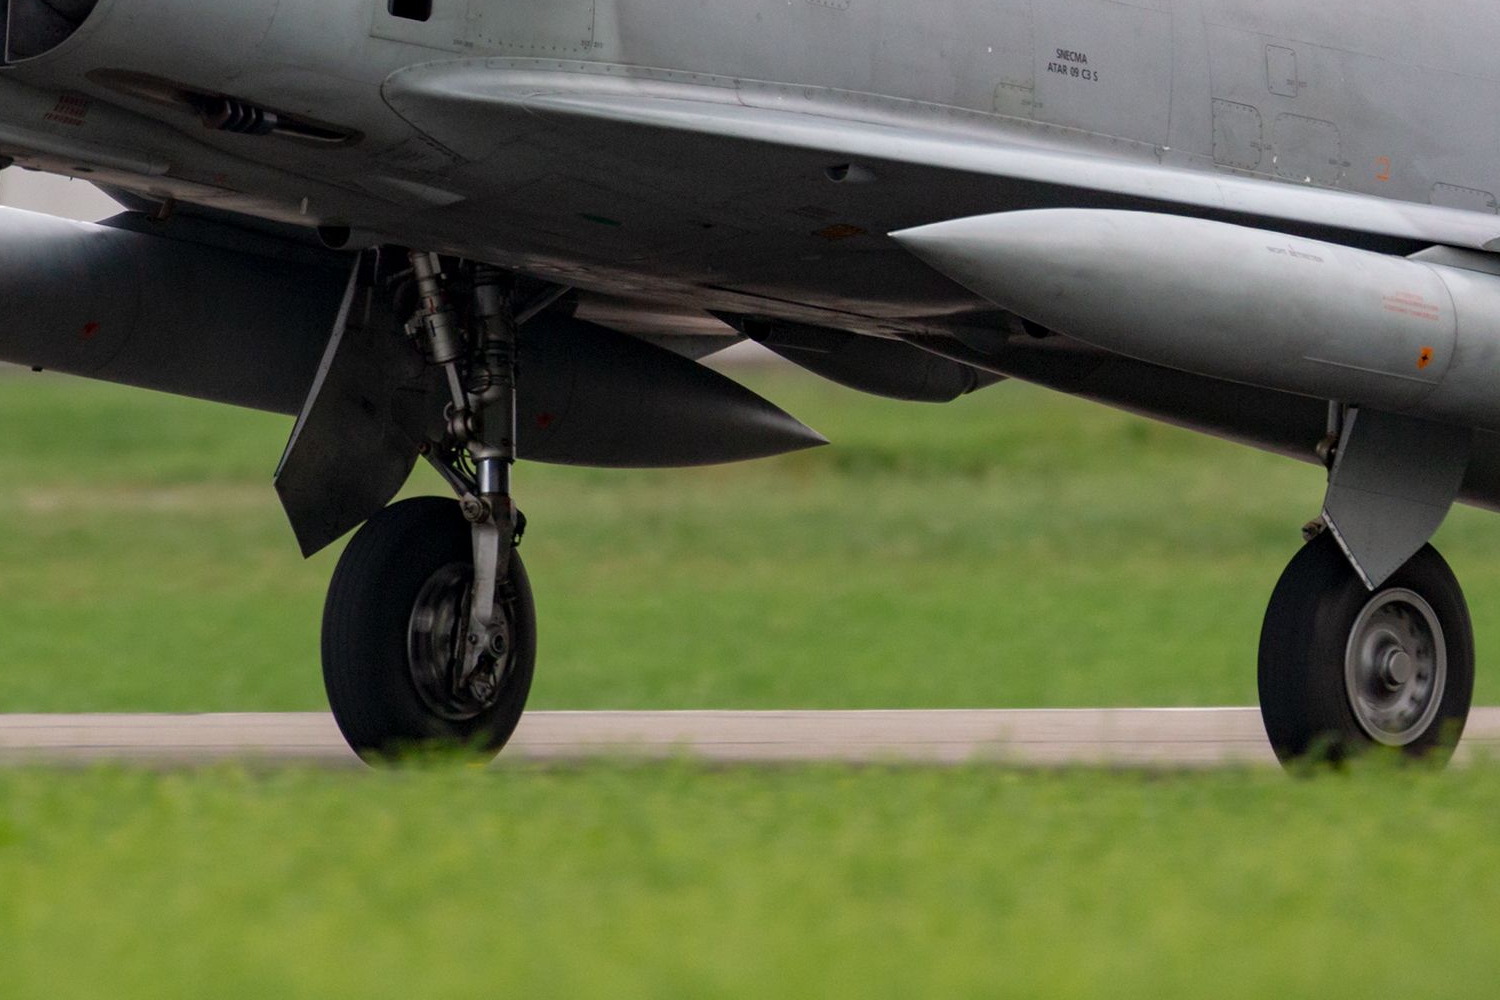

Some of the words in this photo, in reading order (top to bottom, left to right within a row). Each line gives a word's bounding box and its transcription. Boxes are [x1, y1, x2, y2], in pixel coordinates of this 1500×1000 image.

[1056, 48, 1088, 64] SNECMA
[1047, 61, 1068, 76] ATAR
[1070, 66, 1079, 78] 09
[1081, 68, 1091, 80] C3
[1093, 71, 1099, 82] S
